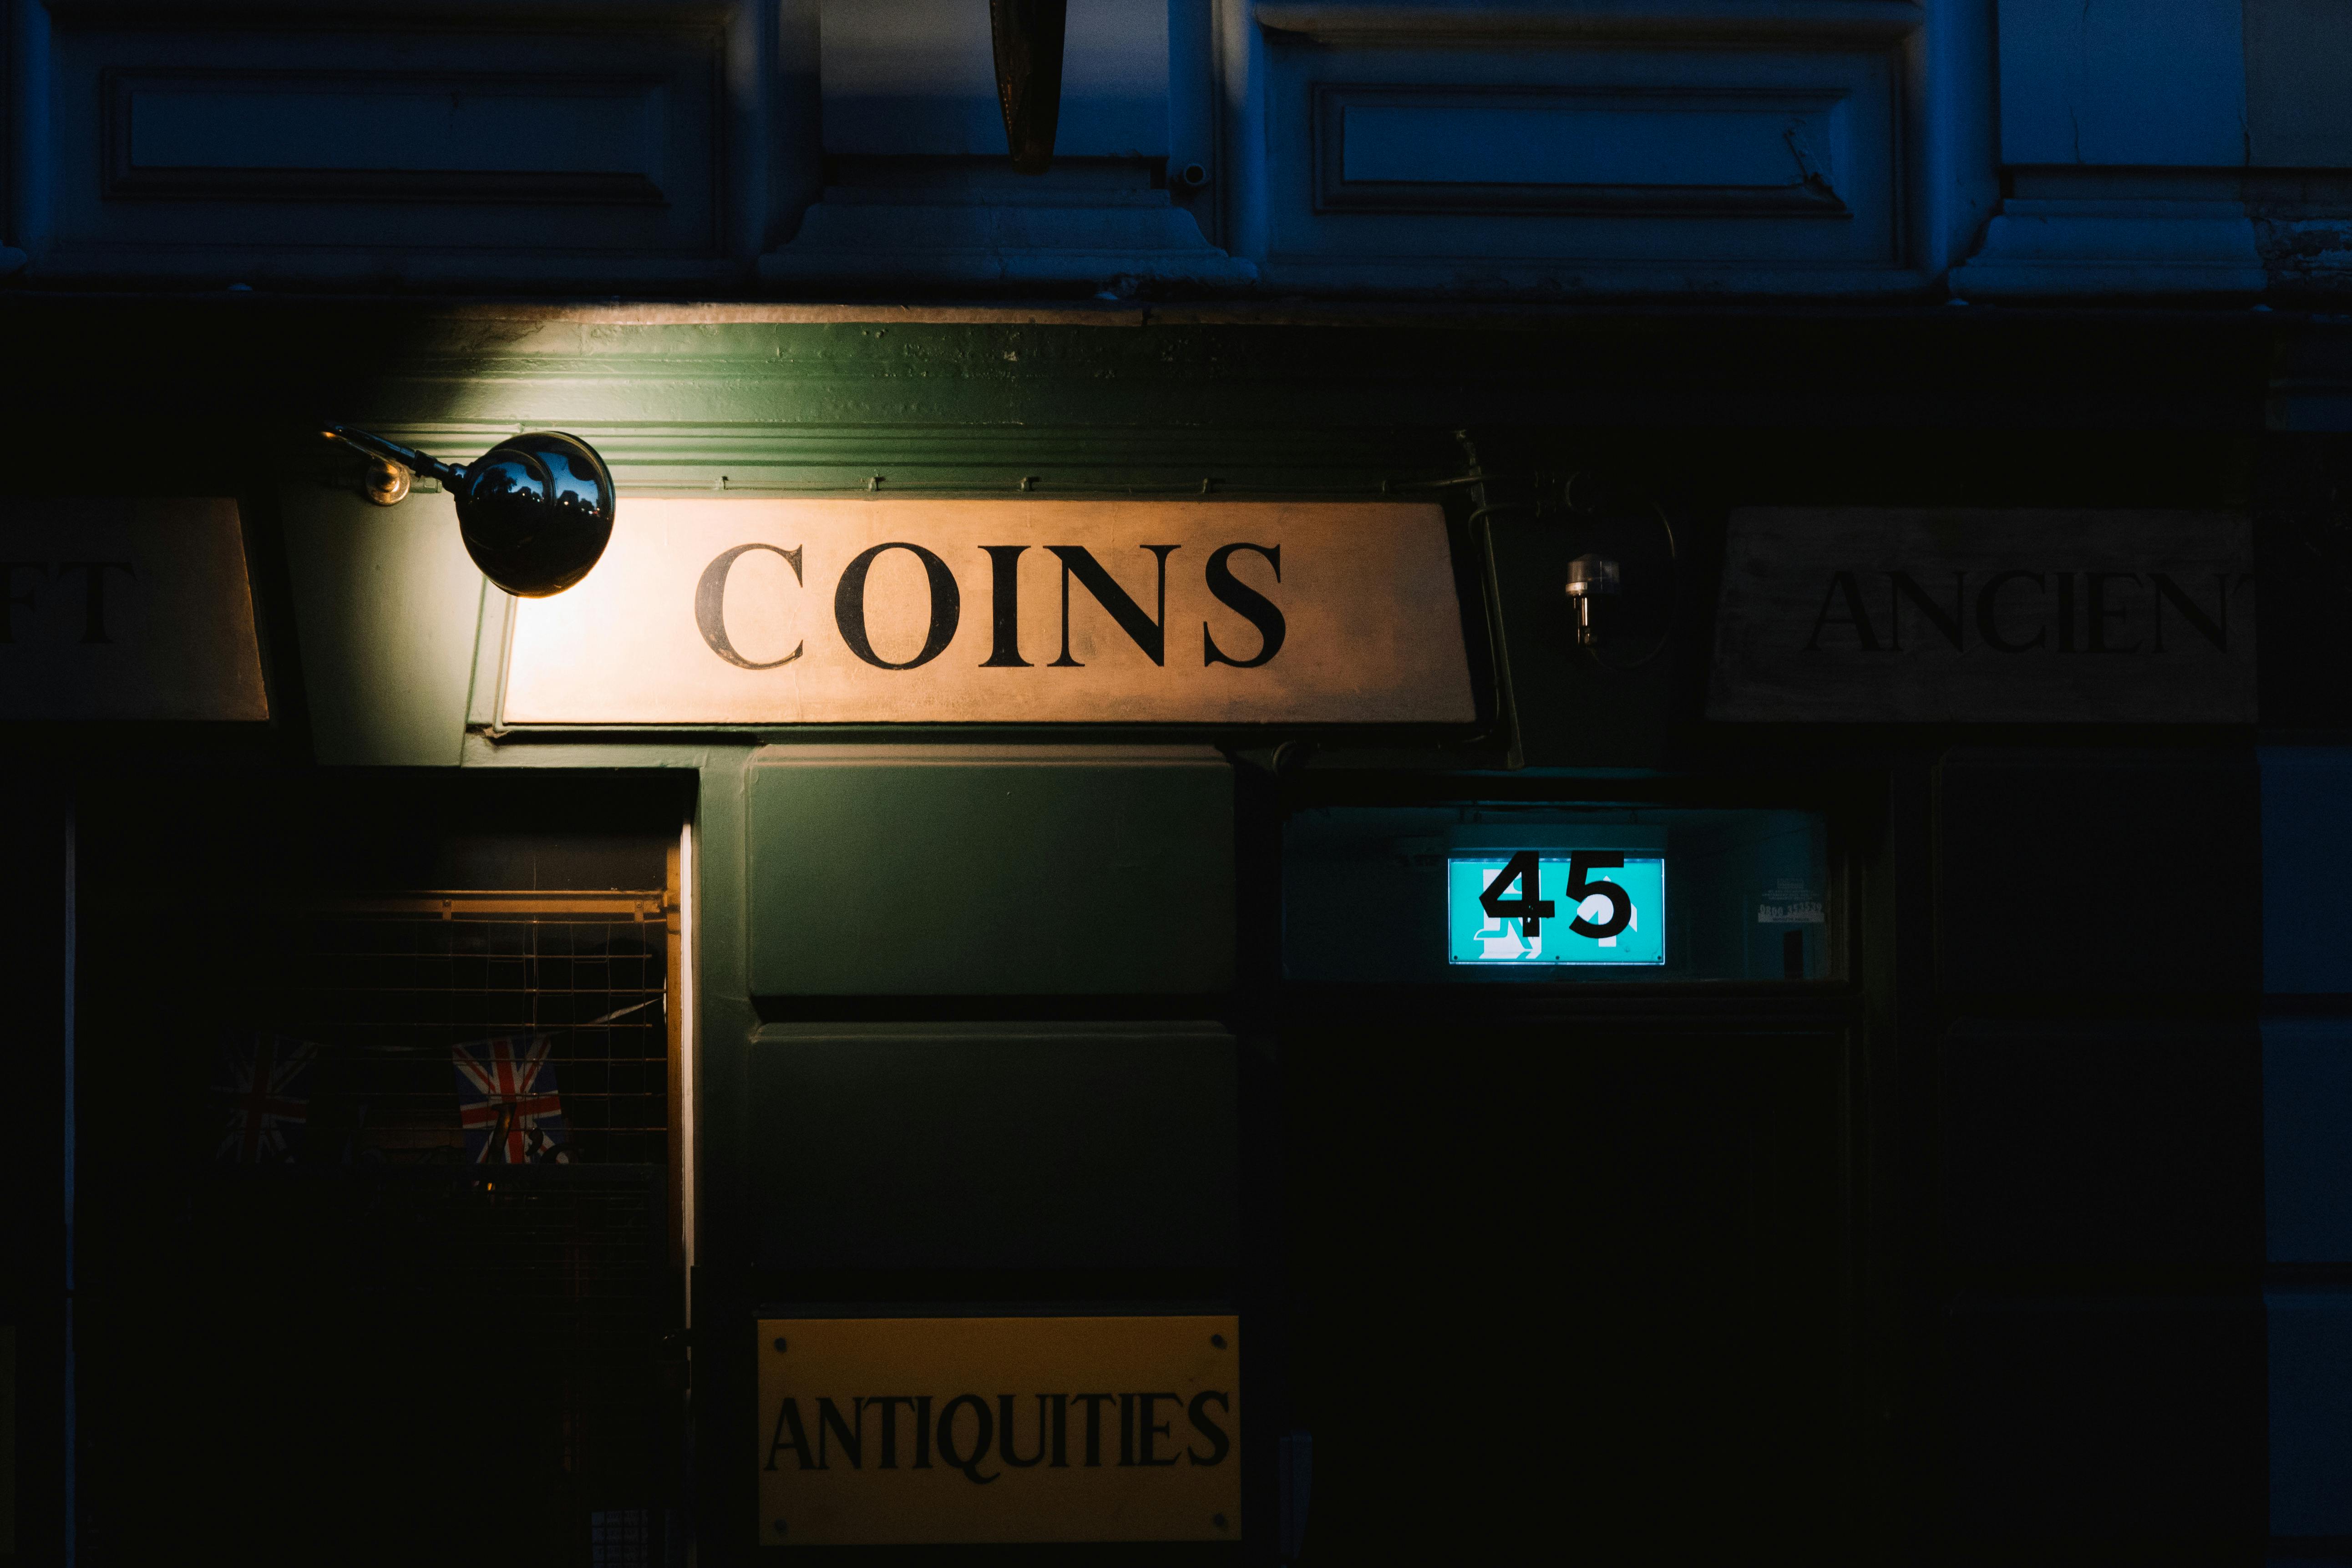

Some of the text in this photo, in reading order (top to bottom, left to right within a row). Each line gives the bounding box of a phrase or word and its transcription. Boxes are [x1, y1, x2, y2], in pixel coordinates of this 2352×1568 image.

[694, 542, 1286, 670] COINS
[1801, 569, 2256, 654] ANCIEN
[1479, 851, 1631, 939] 45
[763, 1390, 1230, 1484] ANTIQUITIES
